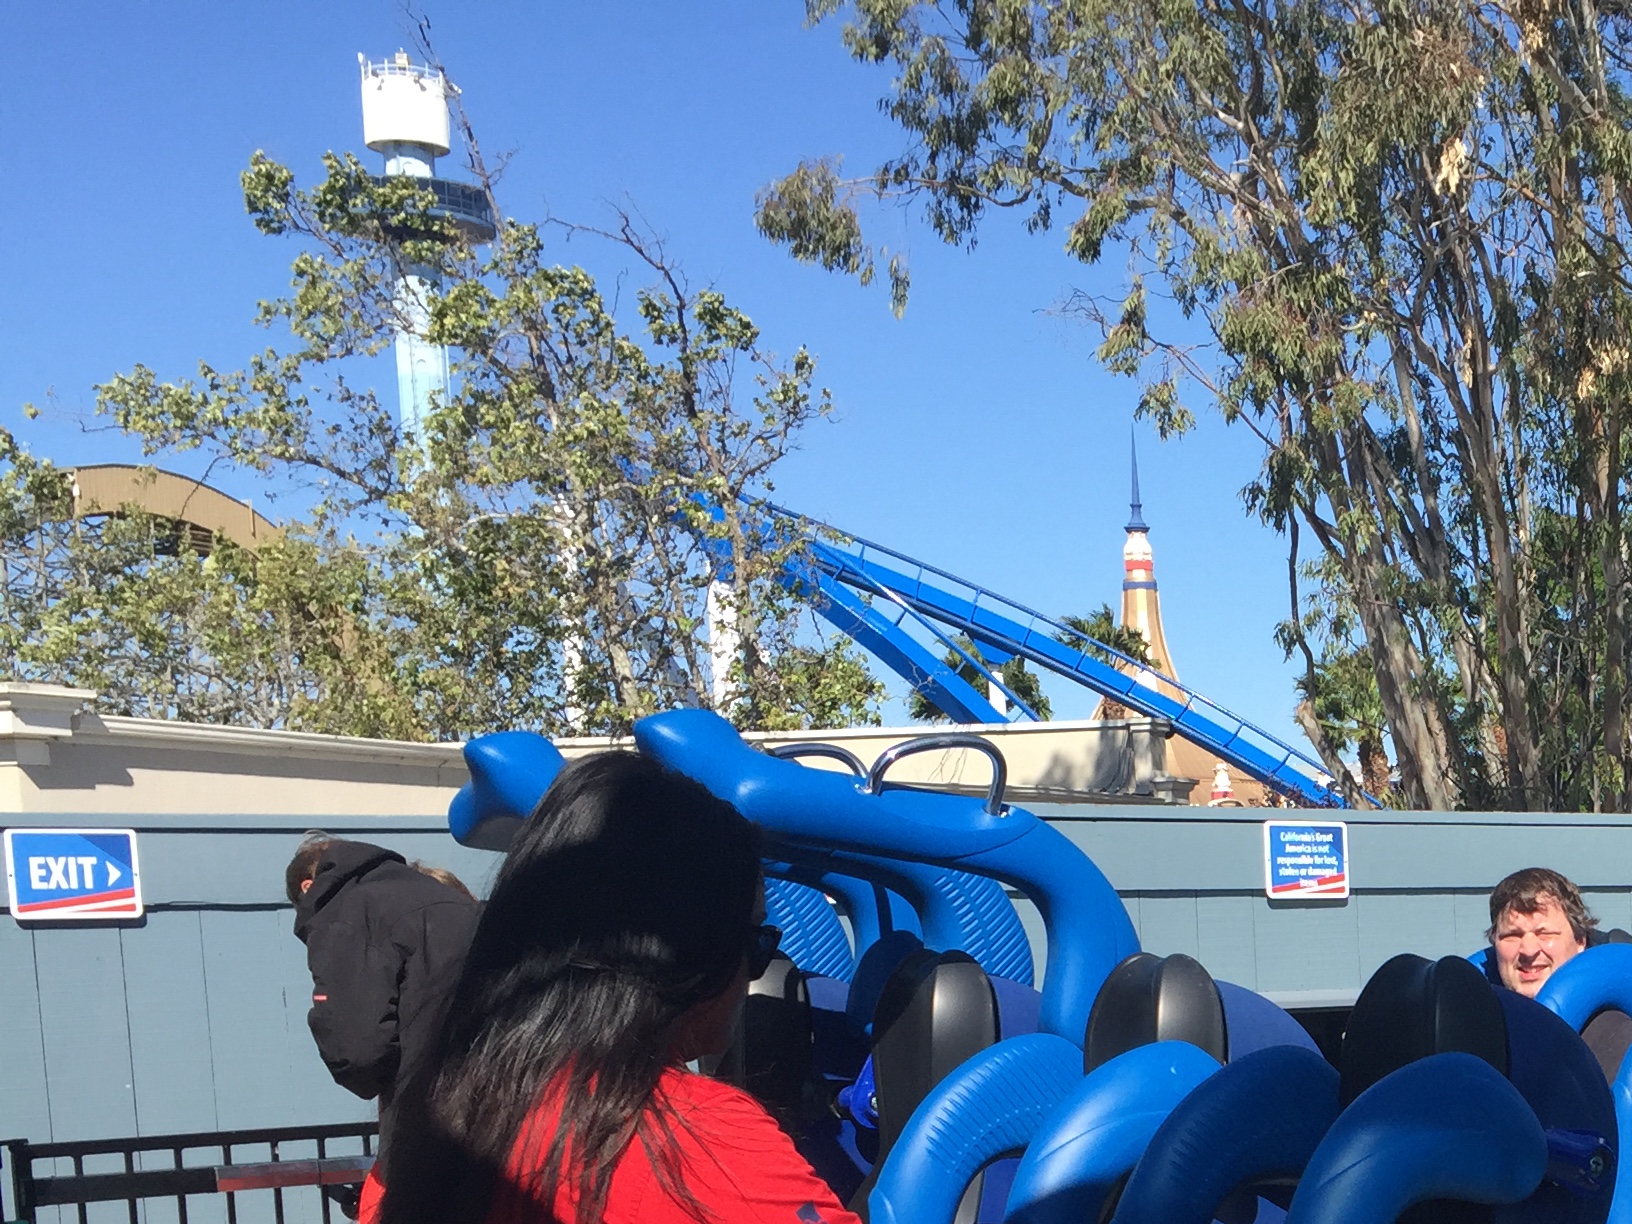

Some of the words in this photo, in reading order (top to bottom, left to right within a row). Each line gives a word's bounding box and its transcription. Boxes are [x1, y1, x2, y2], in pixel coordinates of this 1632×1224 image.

[1280, 832, 1315, 842] California's
[1316, 832, 1333, 842] Great
[1285, 844, 1311, 853] America
[1312, 844, 1318, 853] is
[1318, 845, 1329, 853] not
[1277, 855, 1313, 866] responsible
[1314, 855, 1324, 864] for
[28, 856, 98, 890] EXIT
[1278, 867, 1299, 876] stolen
[1299, 868, 1307, 876] or
[1308, 867, 1337, 878] damaged
